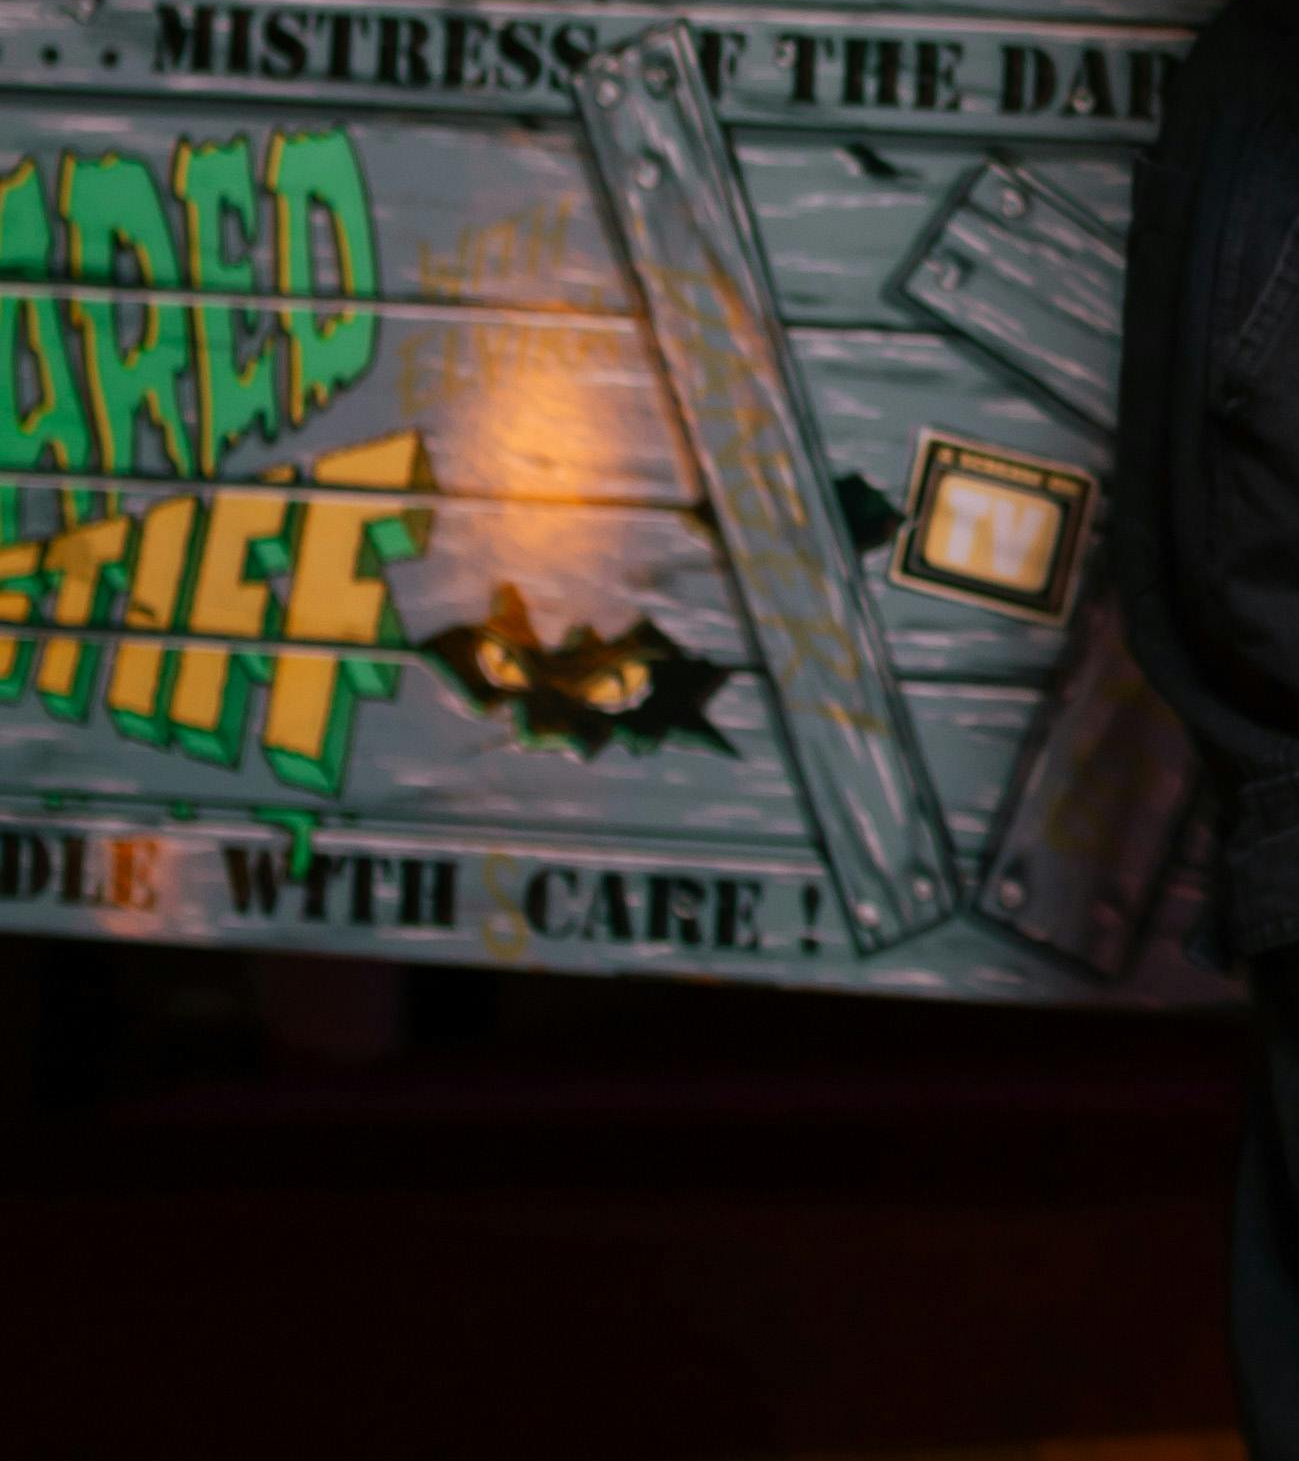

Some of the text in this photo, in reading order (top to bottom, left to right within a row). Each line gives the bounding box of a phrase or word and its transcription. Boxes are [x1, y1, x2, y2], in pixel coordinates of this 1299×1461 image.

[153, 0, 598, 94] MISTRESS
[775, 29, 966, 112] THE
[945, 485, 1047, 579] TV
[220, 840, 460, 927] WITH
